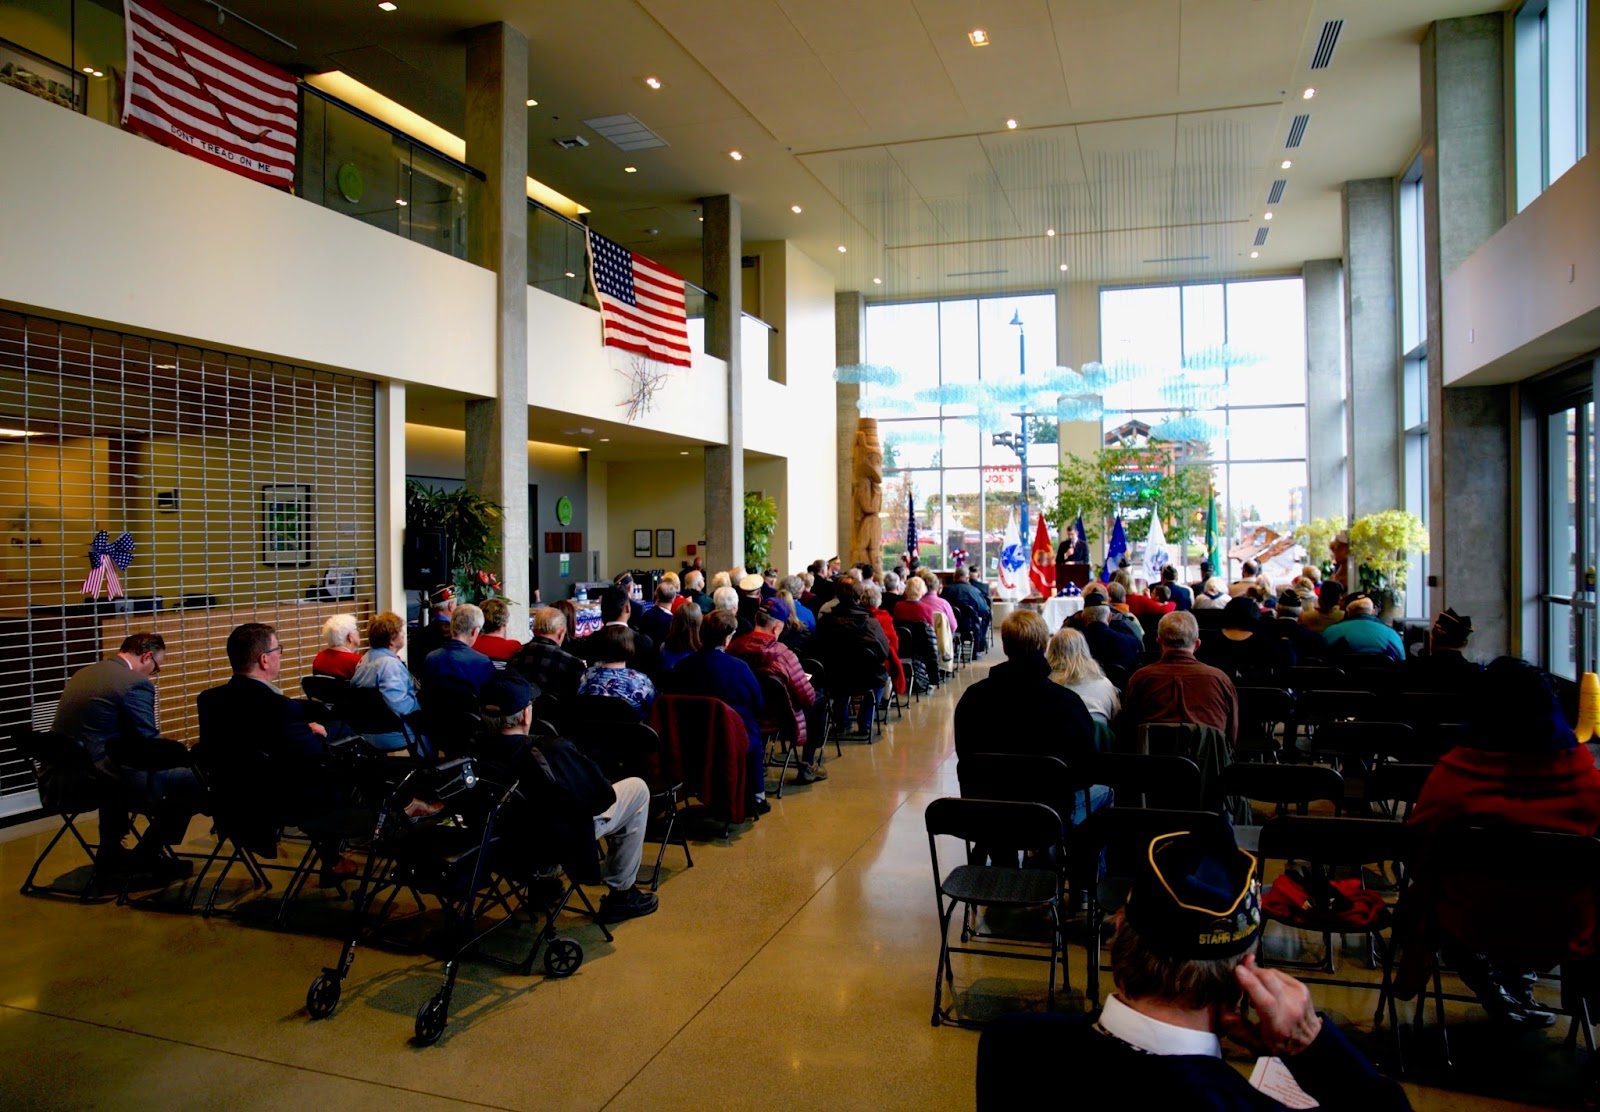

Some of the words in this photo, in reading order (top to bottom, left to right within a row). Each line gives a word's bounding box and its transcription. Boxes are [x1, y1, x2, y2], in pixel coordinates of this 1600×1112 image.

[170, 125, 194, 144] DONT
[201, 141, 234, 160] TREAD
[239, 156, 252, 167] ON
[258, 162, 271, 173] ME
